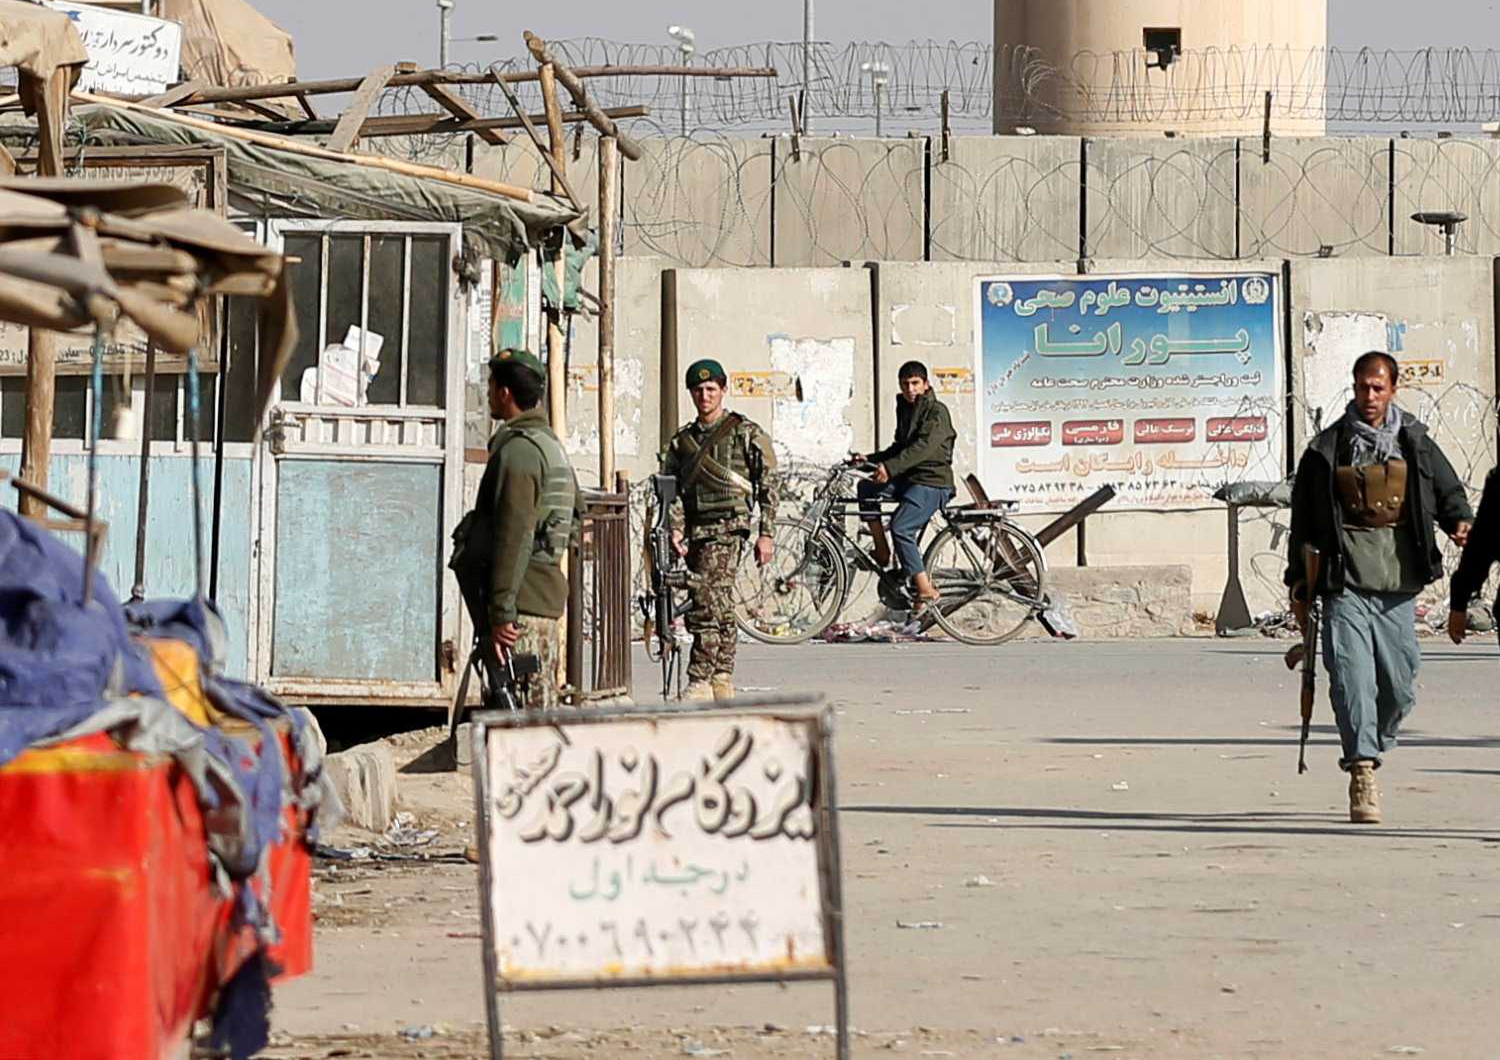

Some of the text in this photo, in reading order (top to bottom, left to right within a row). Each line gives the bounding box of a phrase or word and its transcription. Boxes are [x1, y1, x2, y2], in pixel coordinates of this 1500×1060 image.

[1014, 279, 1238, 316] انستیتیوت علوم صحی
[1034, 321, 1251, 366] پورانا
[1030, 376, 1055, 389] عامه
[1056, 378, 1088, 389] صحت
[1089, 376, 1126, 390] محترم
[1128, 374, 1164, 388] وزارت
[1165, 374, 1190, 386] شده
[1065, 420, 1120, 436] فارمسی
[1015, 452, 1071, 473] است
[569, 854, 632, 900] اول
